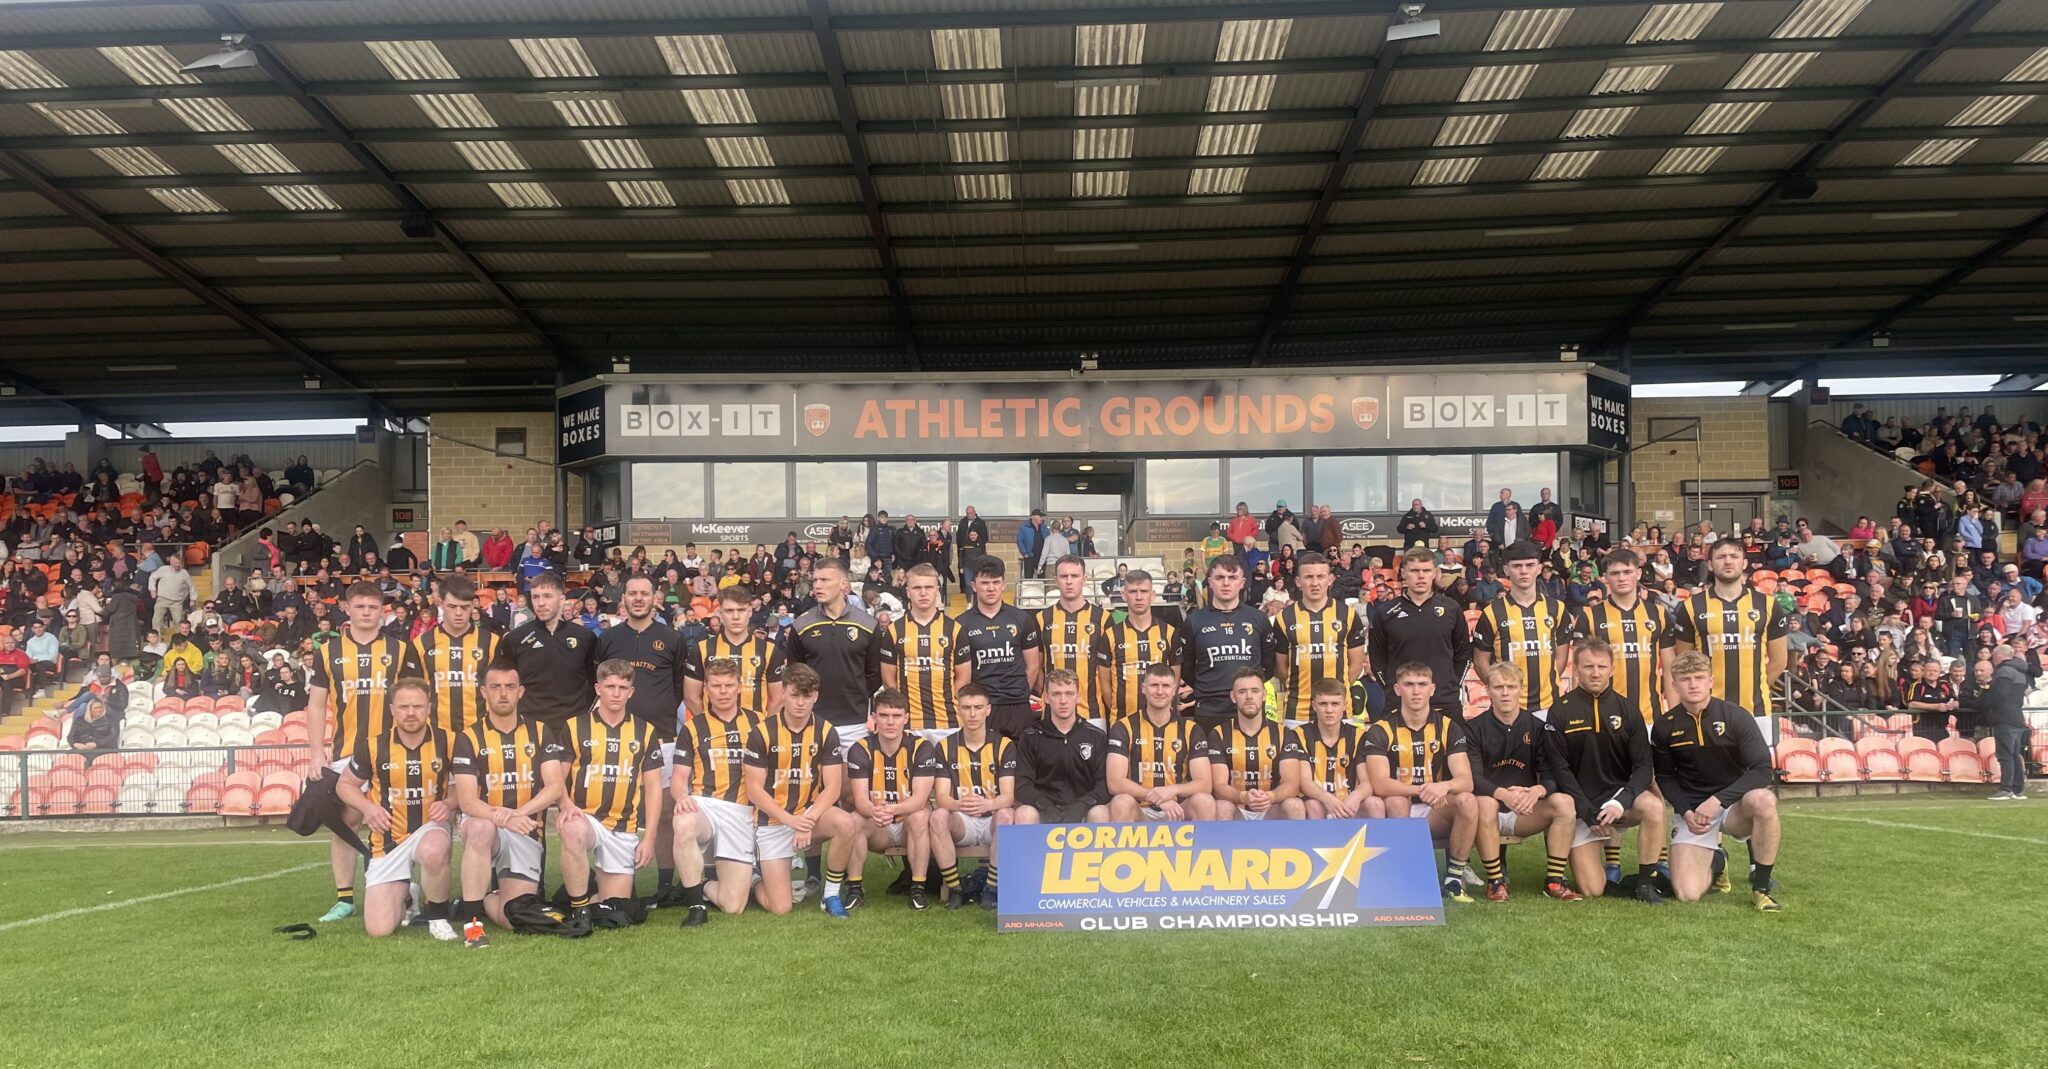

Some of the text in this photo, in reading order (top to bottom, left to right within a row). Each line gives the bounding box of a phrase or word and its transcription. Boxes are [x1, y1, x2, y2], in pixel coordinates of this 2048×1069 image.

[1407, 398, 1563, 425] BOX-IT
[1590, 394, 1625, 417] WE MAKE
[563, 406, 600, 429] WE MAKE
[624, 408, 776, 432] BOX-IT
[853, 394, 1336, 439] ATHLETIC GROUNDS
[1591, 412, 1625, 435] BOXES
[562, 424, 600, 447] BOXES
[1780, 478, 1798, 488] 105
[394, 511, 411, 520] 108
[1440, 516, 1488, 527] McKeev
[691, 523, 750, 534] McKeever
[1342, 522, 1369, 531] ASEE
[720, 534, 749, 542] SPORTS
[1524, 620, 1535, 629] 32
[1726, 614, 1736, 622] 14
[1067, 625, 1075, 634] 12
[1224, 627, 1234, 635] 16
[1314, 624, 1320, 633] 8
[1624, 623, 1634, 632] 21
[920, 638, 929, 647] 18
[1139, 643, 1148, 652] 17
[1508, 633, 1552, 662] pmk
[1707, 626, 1757, 657] pmk
[450, 650, 461, 660] 34
[976, 641, 1015, 670] pmk
[1049, 638, 1091, 664] pmk
[1207, 638, 1252, 668] pmk
[1295, 636, 1339, 666] pmk
[359, 658, 370, 667] 27
[904, 651, 945, 677] pmk
[434, 664, 478, 693] pmk
[340, 671, 388, 704] pmk
[607, 742, 618, 752] 30
[728, 735, 739, 743] 23
[504, 749, 514, 760] 35
[1249, 751, 1255, 760] 6
[1415, 745, 1424, 756] 19
[707, 748, 744, 771] pm
[408, 765, 420, 776] 25
[583, 758, 634, 788] pmk
[772, 762, 813, 789] pmk
[885, 771, 895, 780] 33
[1138, 756, 1176, 783] pmk
[486, 763, 535, 797] pmk
[1315, 773, 1350, 793] mk
[1046, 824, 1195, 849] CORMAC
[1040, 848, 1313, 894] LEONARD
[1038, 894, 1286, 910] COMMERCIAL VEHICLES & MACHINERY SALES
[1004, 921, 1023, 929] ARD
[1080, 912, 1359, 931] CLUB CHAMPIONSHIP
[1374, 914, 1392, 922] ARD
